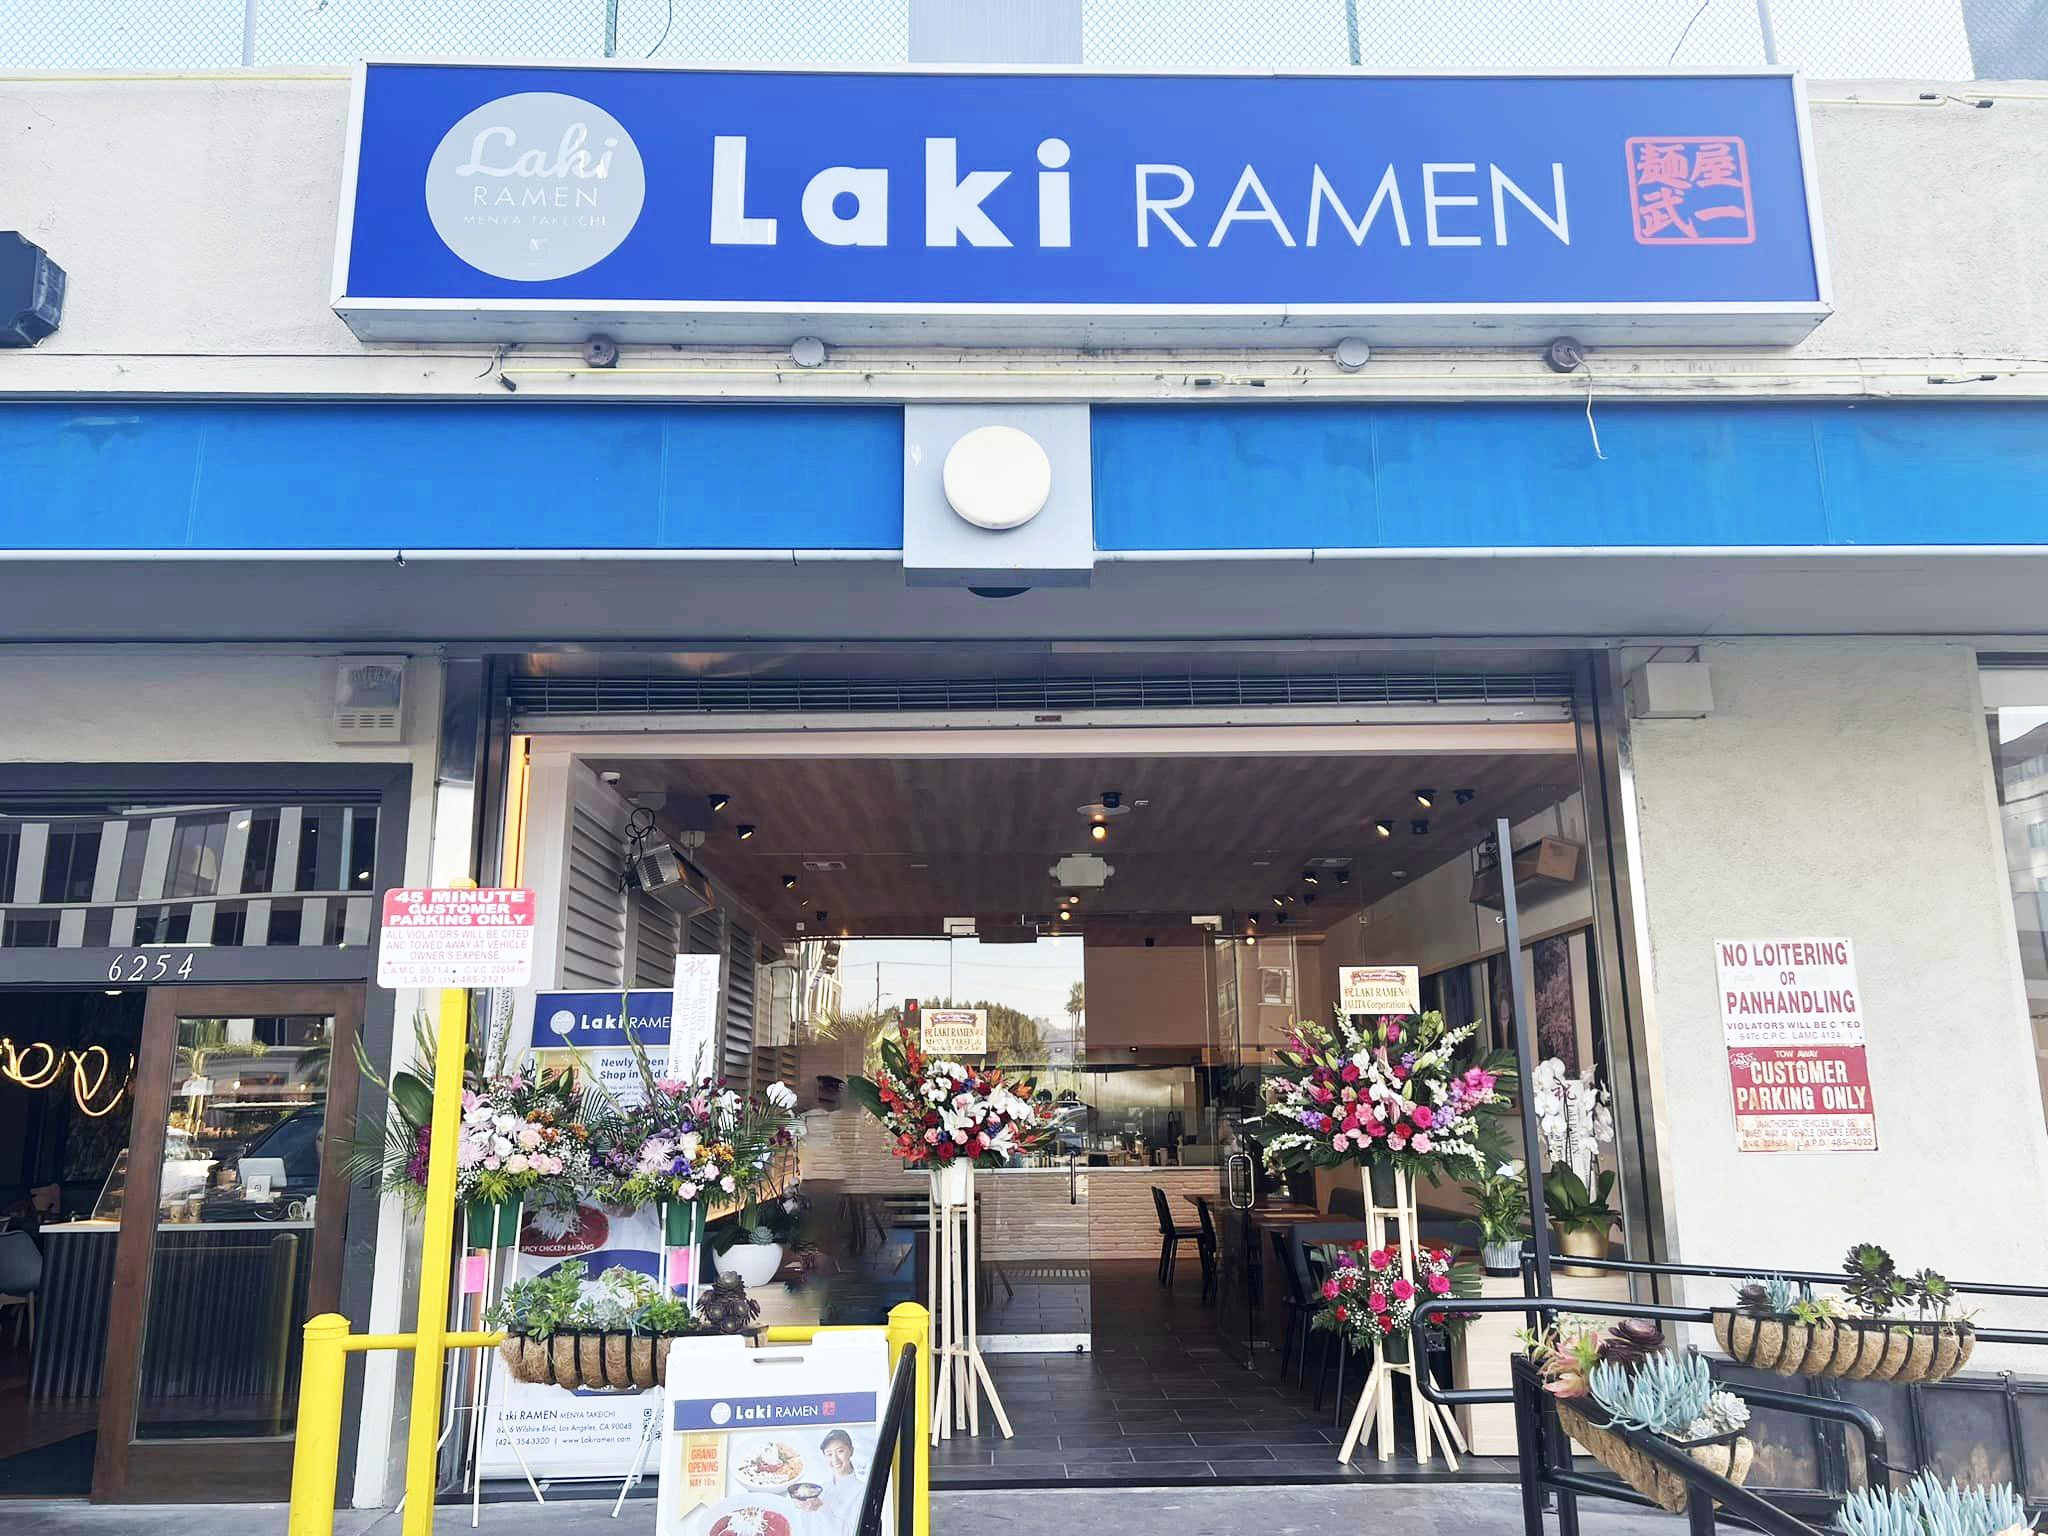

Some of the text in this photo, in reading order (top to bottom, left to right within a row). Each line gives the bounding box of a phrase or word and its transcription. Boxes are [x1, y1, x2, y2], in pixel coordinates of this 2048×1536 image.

[456, 121, 619, 179] Laki
[474, 185, 600, 208] RAMEN
[711, 136, 1569, 248] Laki RAMEN
[394, 890, 526, 903] 45 MINUTE
[408, 903, 510, 915] CUSTOMER
[390, 913, 527, 926] PARKING ONLY
[386, 929, 529, 940] ALL VIOLATORS WILL BE CITED
[386, 940, 527, 950] AND TOWED AWAY AT VEHICLE
[409, 951, 454, 960] OWNER'S
[1721, 942, 1848, 966] NO LOITERING
[109, 952, 194, 982] 6254
[1780, 971, 1797, 986] OR
[1355, 987, 1373, 997] LAKI
[1376, 987, 1405, 997] RAMEN
[1367, 999, 1406, 1010] Corporation
[1726, 989, 1857, 1014] PANHANDLING
[581, 1013, 624, 1030] Laki
[629, 1015, 672, 1029] RAME
[1727, 1020, 1861, 1031] VIOLATORS WILL BE CTED
[934, 1027, 950, 1038] LAKI
[951, 1027, 974, 1037] RAMEN
[1774, 1049, 1818, 1059] TOW AWAY
[601, 1057, 634, 1069] Newly
[600, 1070, 626, 1081] Shop
[629, 1069, 639, 1079] in
[1750, 1059, 1849, 1085] CUSTOMER
[1736, 1085, 1867, 1111] PARKING ONLY
[539, 1244, 567, 1253] CHICKEN
[520, 1410, 558, 1420] RAMEN
[560, 1411, 585, 1419] MENYA
[586, 1410, 616, 1418] TAKEICHI
[736, 1404, 772, 1420] Laki
[775, 1404, 818, 1418] RAMEN
[497, 1425, 514, 1433] 626
[559, 1423, 571, 1432] Los
[599, 1422, 610, 1431] CA
[611, 1422, 632, 1431] 90048
[691, 1448, 717, 1460] GRAND
[688, 1460, 719, 1474] OPENING
[689, 1479, 702, 1488] MAY
